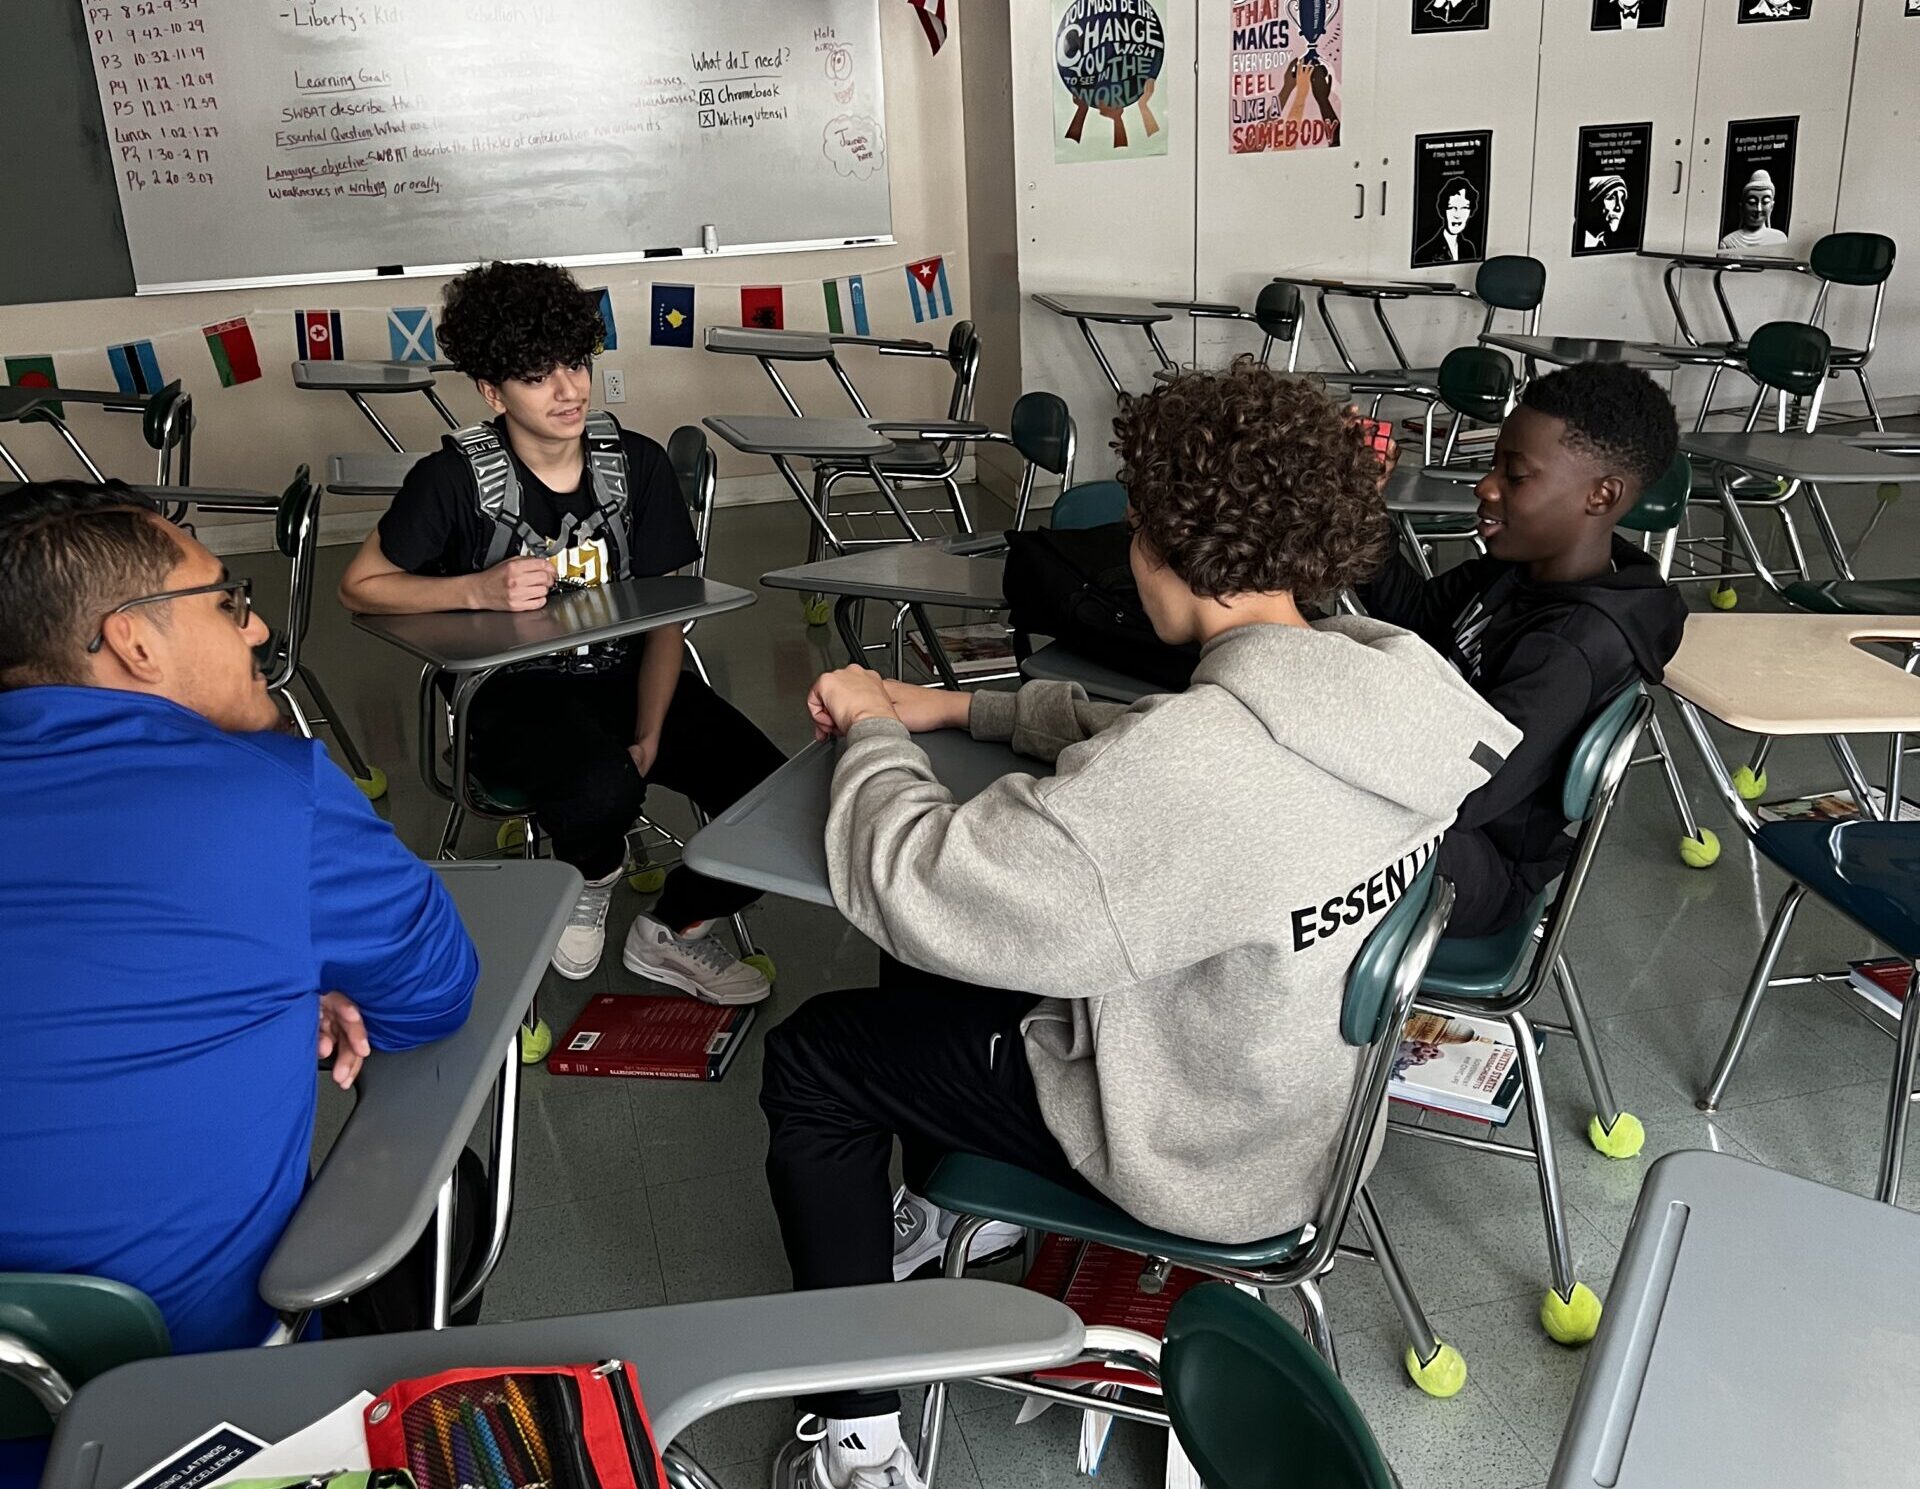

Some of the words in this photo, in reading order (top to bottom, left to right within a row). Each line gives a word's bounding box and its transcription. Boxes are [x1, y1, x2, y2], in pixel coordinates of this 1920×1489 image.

[1064, 0, 1085, 27] YOU
[1087, 0, 1117, 17] MUST
[1120, 0, 1136, 14] BE
[1057, 18, 1164, 67] CHANGE
[1233, 20, 1289, 50] MAKES
[691, 51, 721, 72] What
[1064, 77, 1077, 85] TO
[1080, 75, 1095, 85] SEE
[1107, 55, 1153, 83] THE
[1069, 46, 1105, 77] YOU
[1113, 42, 1155, 58] WISH
[1233, 50, 1293, 72] EVERYBODY
[294, 70, 356, 91] Learning
[1233, 73, 1275, 96] FEEL
[718, 83, 780, 103] Chromebook
[330, 101, 386, 117] describe
[1232, 97, 1265, 123] LIKE
[1271, 95, 1281, 117] A
[115, 127, 152, 143] Lunch
[276, 129, 327, 147] Essential
[1233, 118, 1339, 150] SOMEBODY
[267, 165, 317, 181] Language
[334, 185, 345, 195] in
[394, 181, 407, 194] or
[1291, 835, 1440, 952] ESSENTI
[180, 1444, 227, 1476] LATINOS
